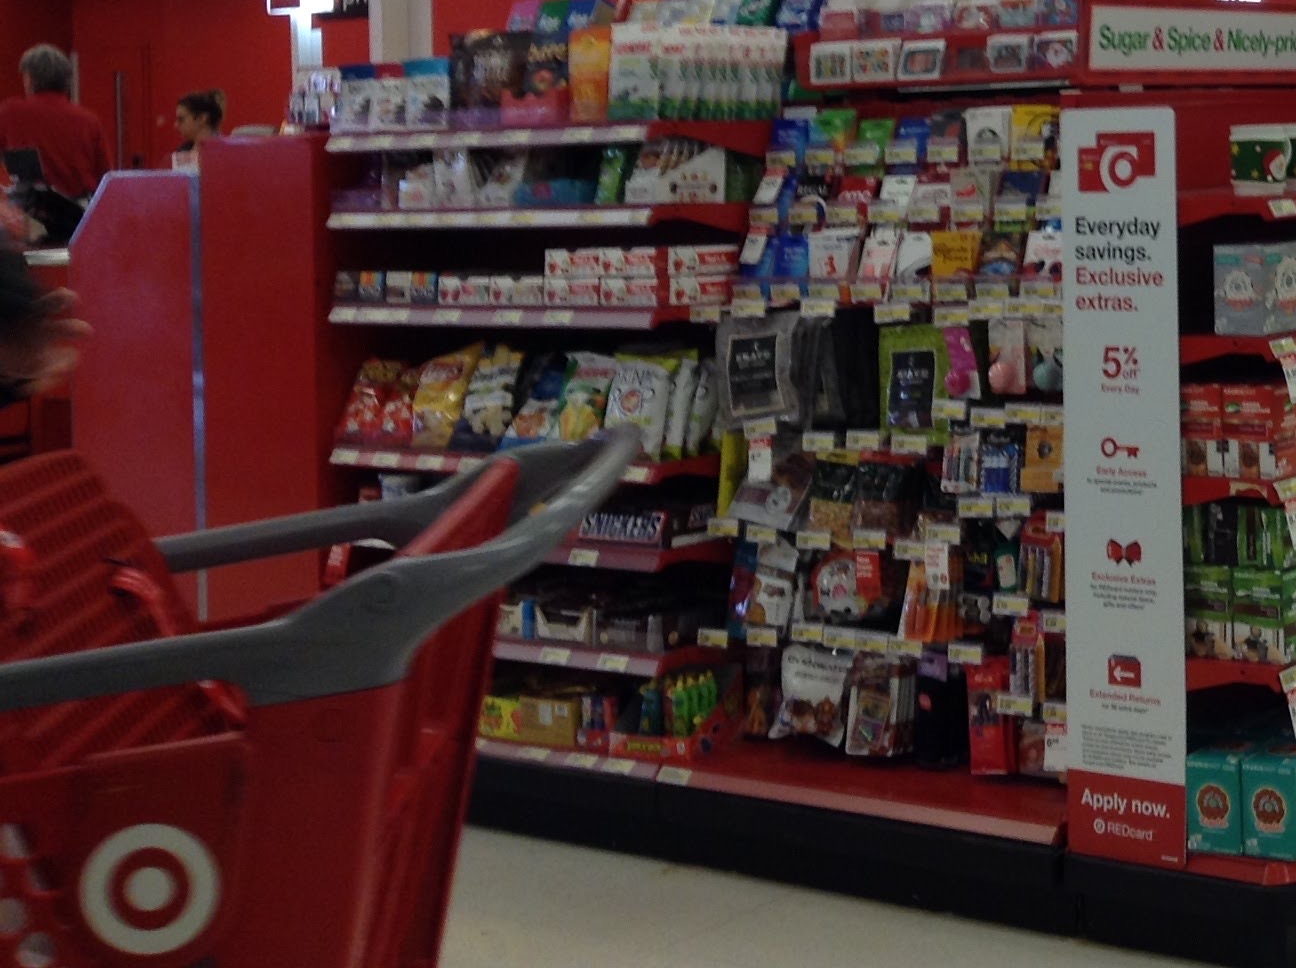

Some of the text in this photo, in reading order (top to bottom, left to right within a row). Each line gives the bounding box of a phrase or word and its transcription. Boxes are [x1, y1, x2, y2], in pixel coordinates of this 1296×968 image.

[1098, 24, 1150, 56] Sugar
[1153, 27, 1164, 51] &
[1167, 28, 1211, 56] Spice
[1214, 30, 1226, 52] &
[1075, 216, 1160, 240] Everyday
[1075, 243, 1151, 265] savings.
[1076, 267, 1163, 286] Exclusive
[1075, 295, 1138, 313] extras.
[1081, 787, 1171, 819] Apply now.
[1107, 821, 1153, 842] REDcard
